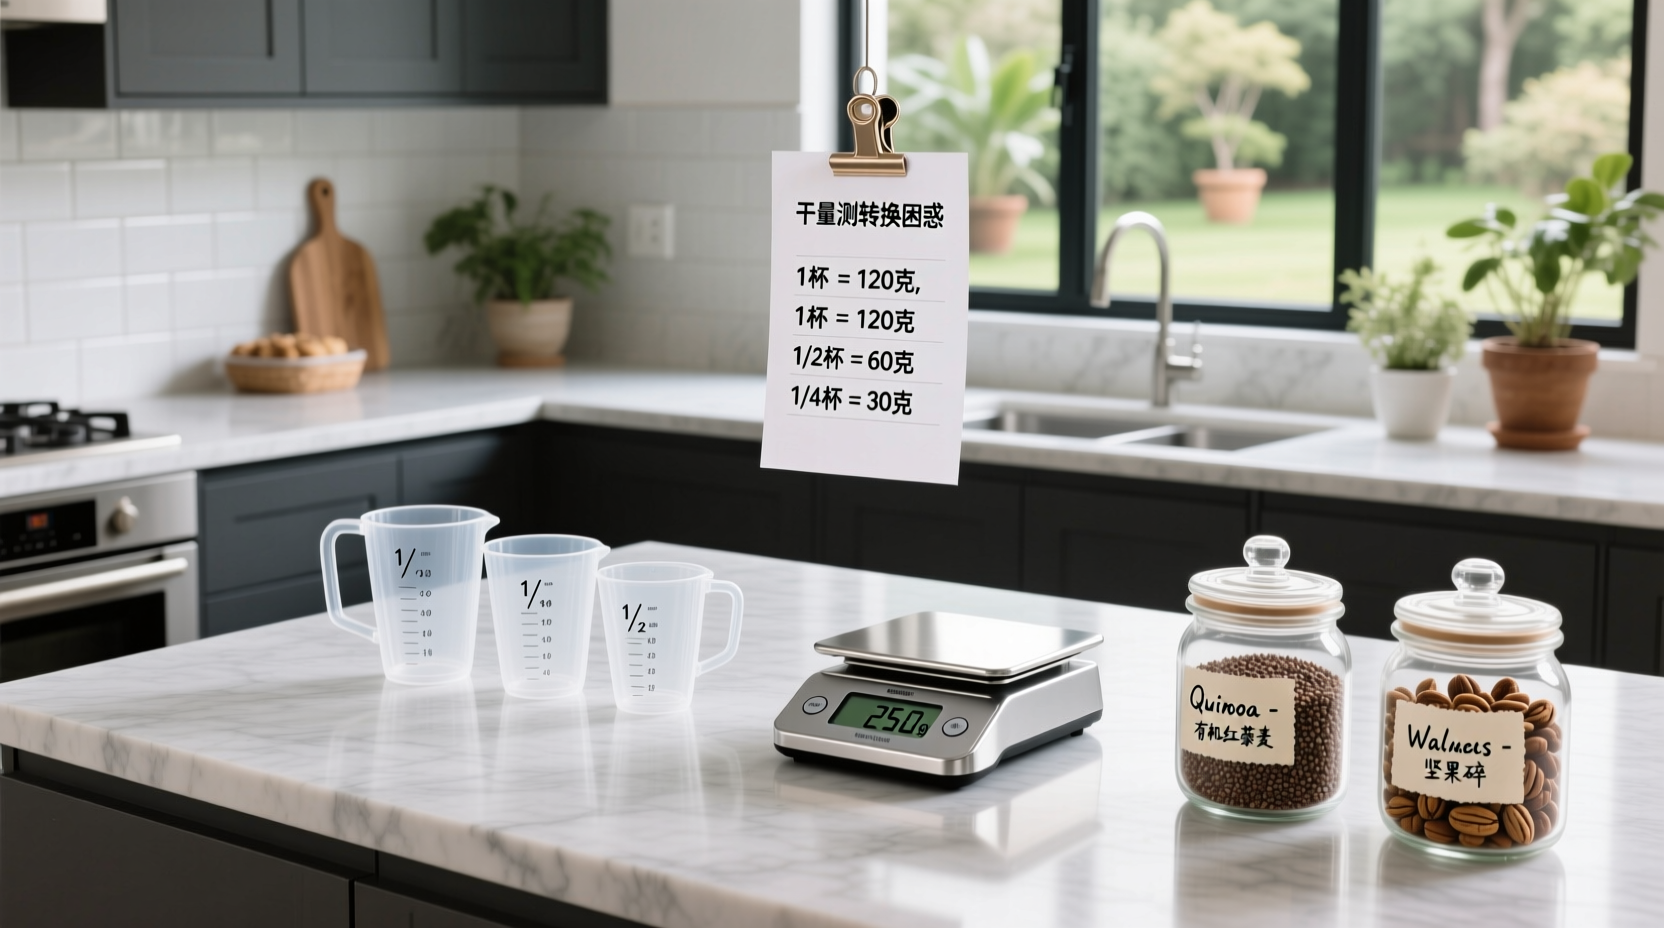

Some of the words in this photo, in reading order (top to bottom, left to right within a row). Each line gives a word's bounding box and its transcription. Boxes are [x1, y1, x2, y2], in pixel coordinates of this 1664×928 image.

[796, 201, 944, 229] 干量测转换困惑
[797, 266, 829, 290] 1杯
[838, 273, 850, 284] =
[858, 268, 921, 295] 120克,
[795, 305, 828, 330] 1杯
[836, 313, 849, 323] =
[857, 309, 915, 334] 120克
[793, 345, 844, 370] 1/2杯
[851, 354, 863, 365] =
[867, 349, 914, 375] 60克
[791, 385, 843, 410] 1/4杯
[849, 395, 861, 406] =
[866, 390, 912, 416] 30克
[622, 603, 646, 633] 1/2
[1424, 758, 1486, 788] 坚果碎
